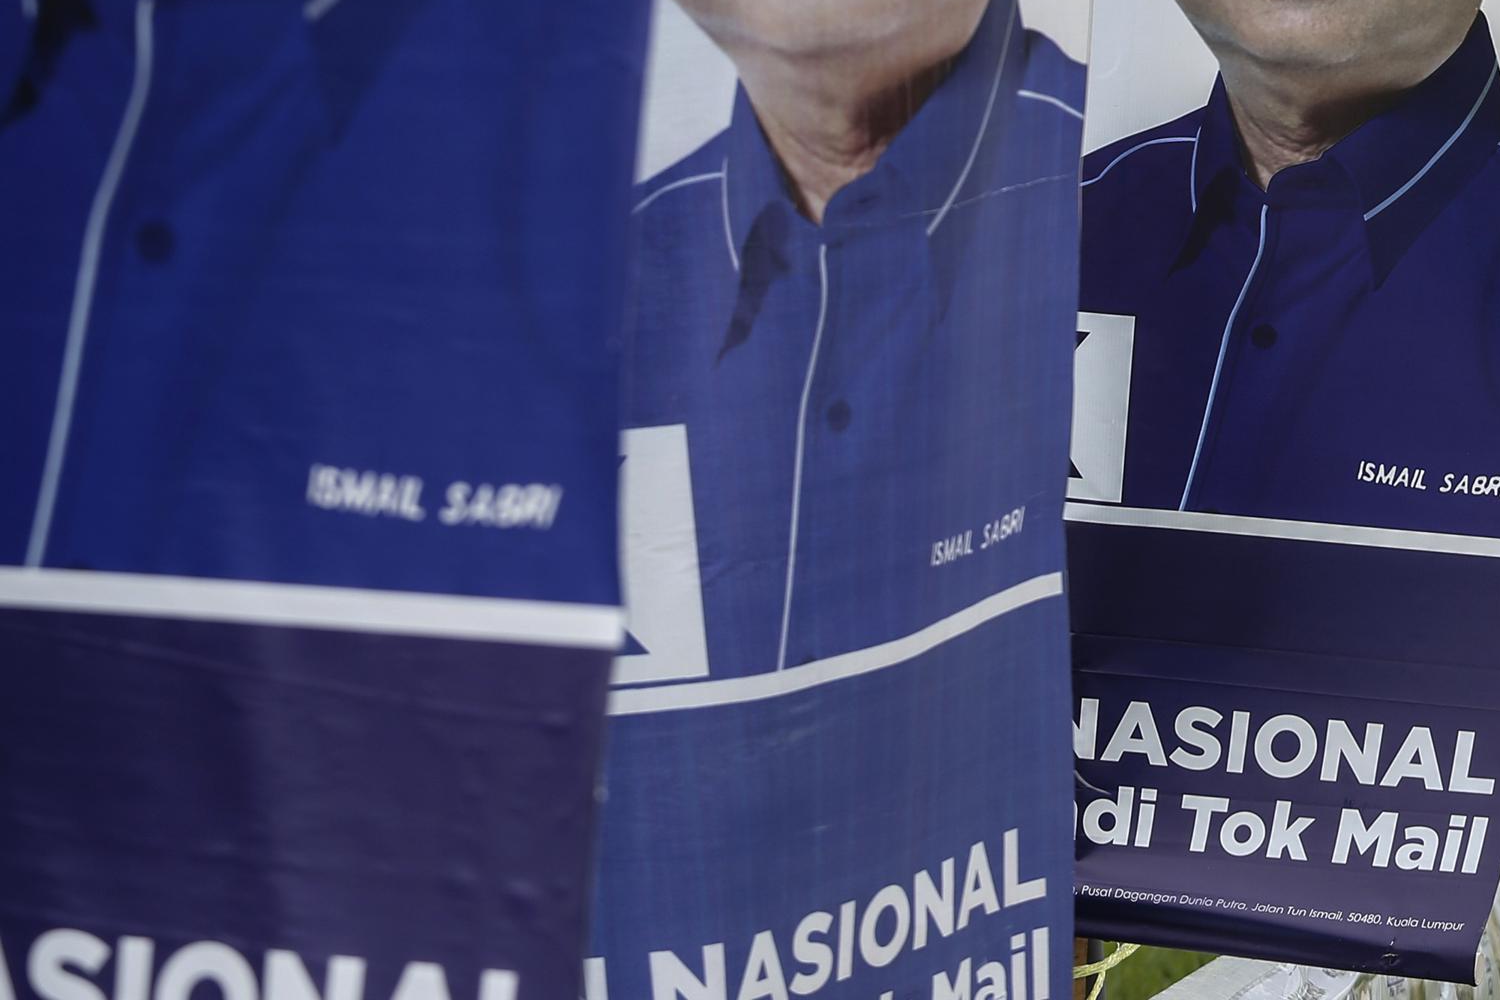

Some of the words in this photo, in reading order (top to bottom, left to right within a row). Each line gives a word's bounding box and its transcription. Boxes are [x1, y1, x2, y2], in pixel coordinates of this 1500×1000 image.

[1357, 460, 1427, 490] ISMAIL
[931, 529, 974, 567] ISMAIL
[980, 505, 1026, 549] SABRI
[1073, 785, 1158, 849] di
[1181, 794, 1316, 861] Tok
[1331, 808, 1490, 874] Mail
[1081, 885, 1112, 898] Pusat
[1114, 888, 1177, 904] Dagangan
[1179, 894, 1214, 908] Dunia
[1215, 898, 1249, 912] Putra,
[1251, 903, 1284, 915] Jalan
[1287, 905, 1307, 917] Tun
[1309, 908, 1344, 922] Ismail,
[1347, 912, 1383, 926] 50480,
[1386, 916, 1419, 928] Kuala
[1421, 918, 1465, 932] Lumpur
